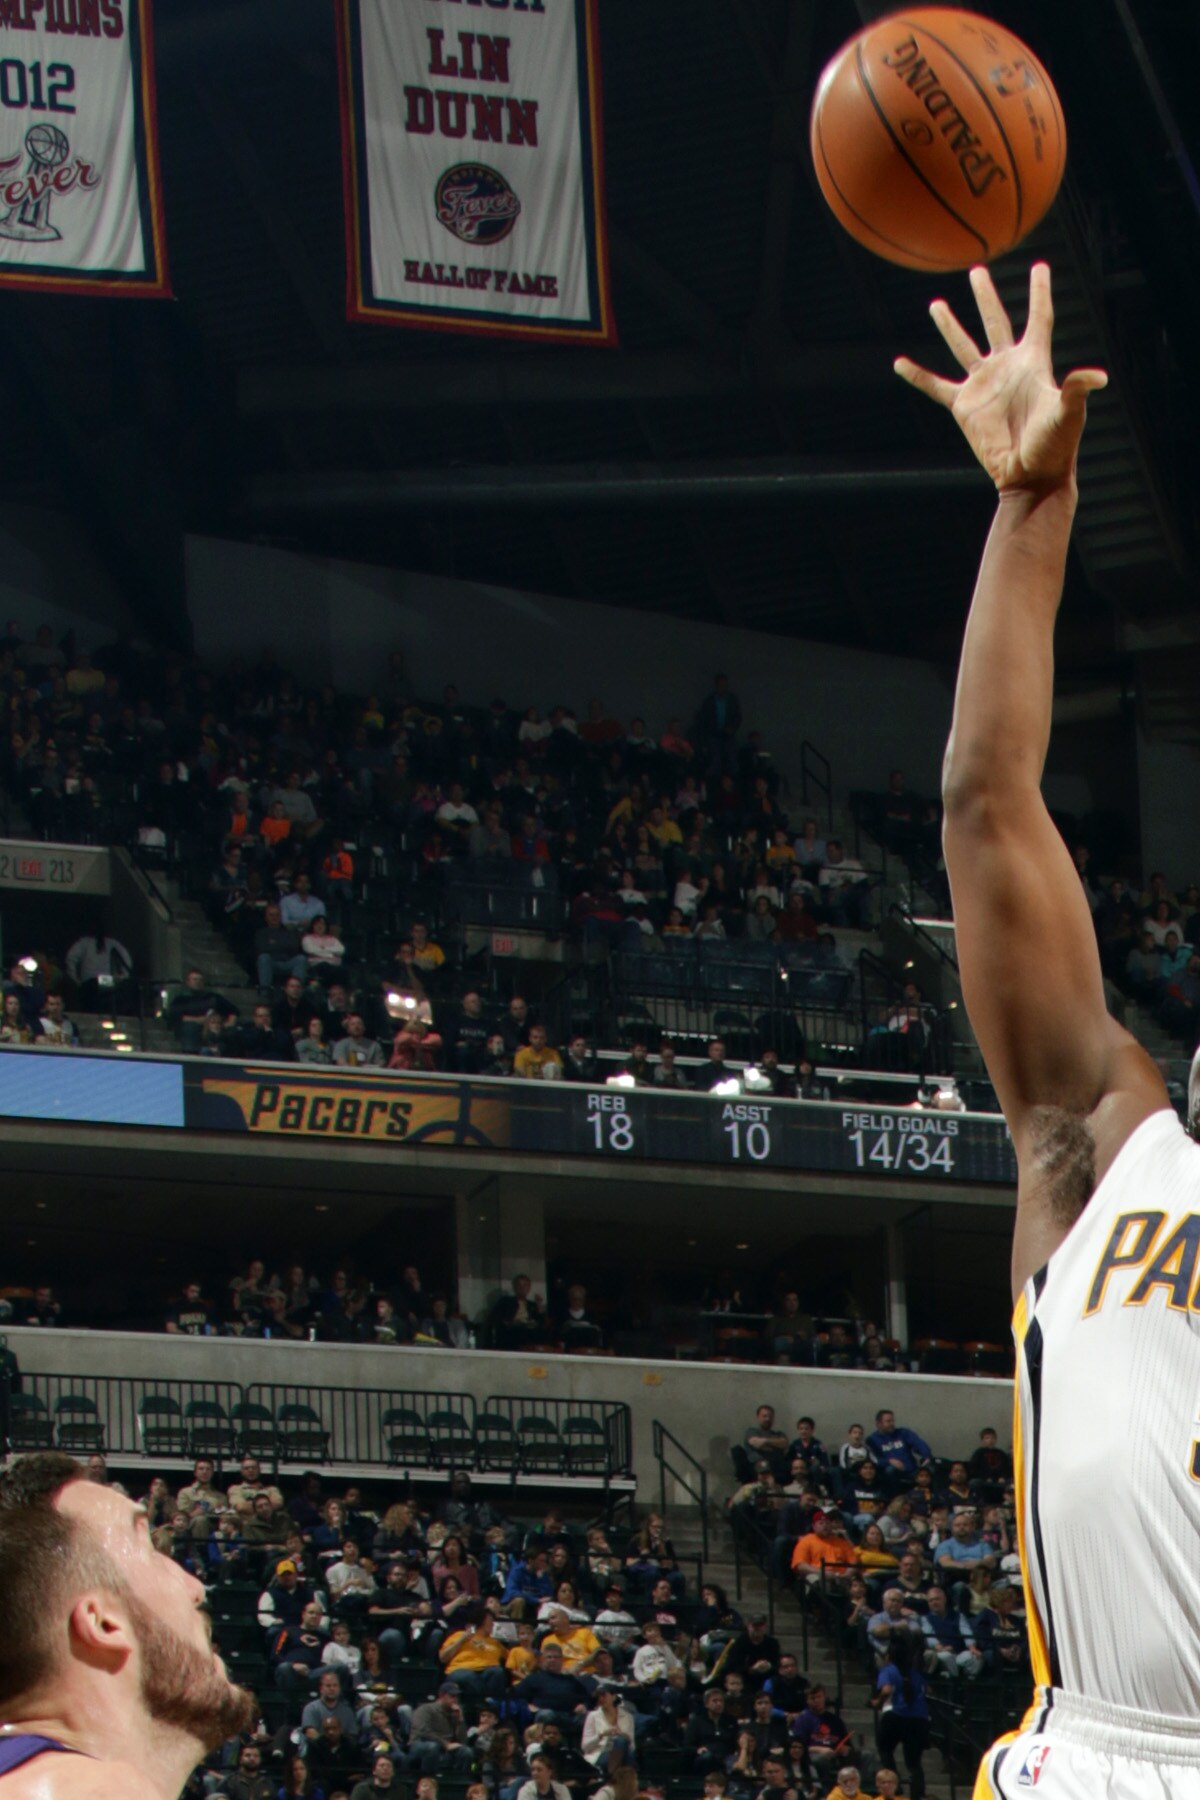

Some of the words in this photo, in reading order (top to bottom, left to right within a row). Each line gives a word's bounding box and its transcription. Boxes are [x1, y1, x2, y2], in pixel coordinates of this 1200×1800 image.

[427, 27, 511, 83] LIN
[403, 85, 539, 147] DUNN
[884, 35, 1006, 197] SPALDING
[437, 182, 521, 225] Fever
[403, 260, 464, 288] HALL
[466, 267, 492, 290] OF
[494, 270, 558, 298] FAME
[49, 859, 74, 883] 213
[250, 1083, 413, 1136] Pacers
[587, 1094, 626, 1112] REB
[722, 1103, 772, 1122] ASST
[586, 1112, 635, 1151] 18
[724, 1121, 771, 1160] 10
[842, 1112, 895, 1131] FIELD
[898, 1116, 959, 1136] GOALS
[848, 1130, 955, 1173] 14/34
